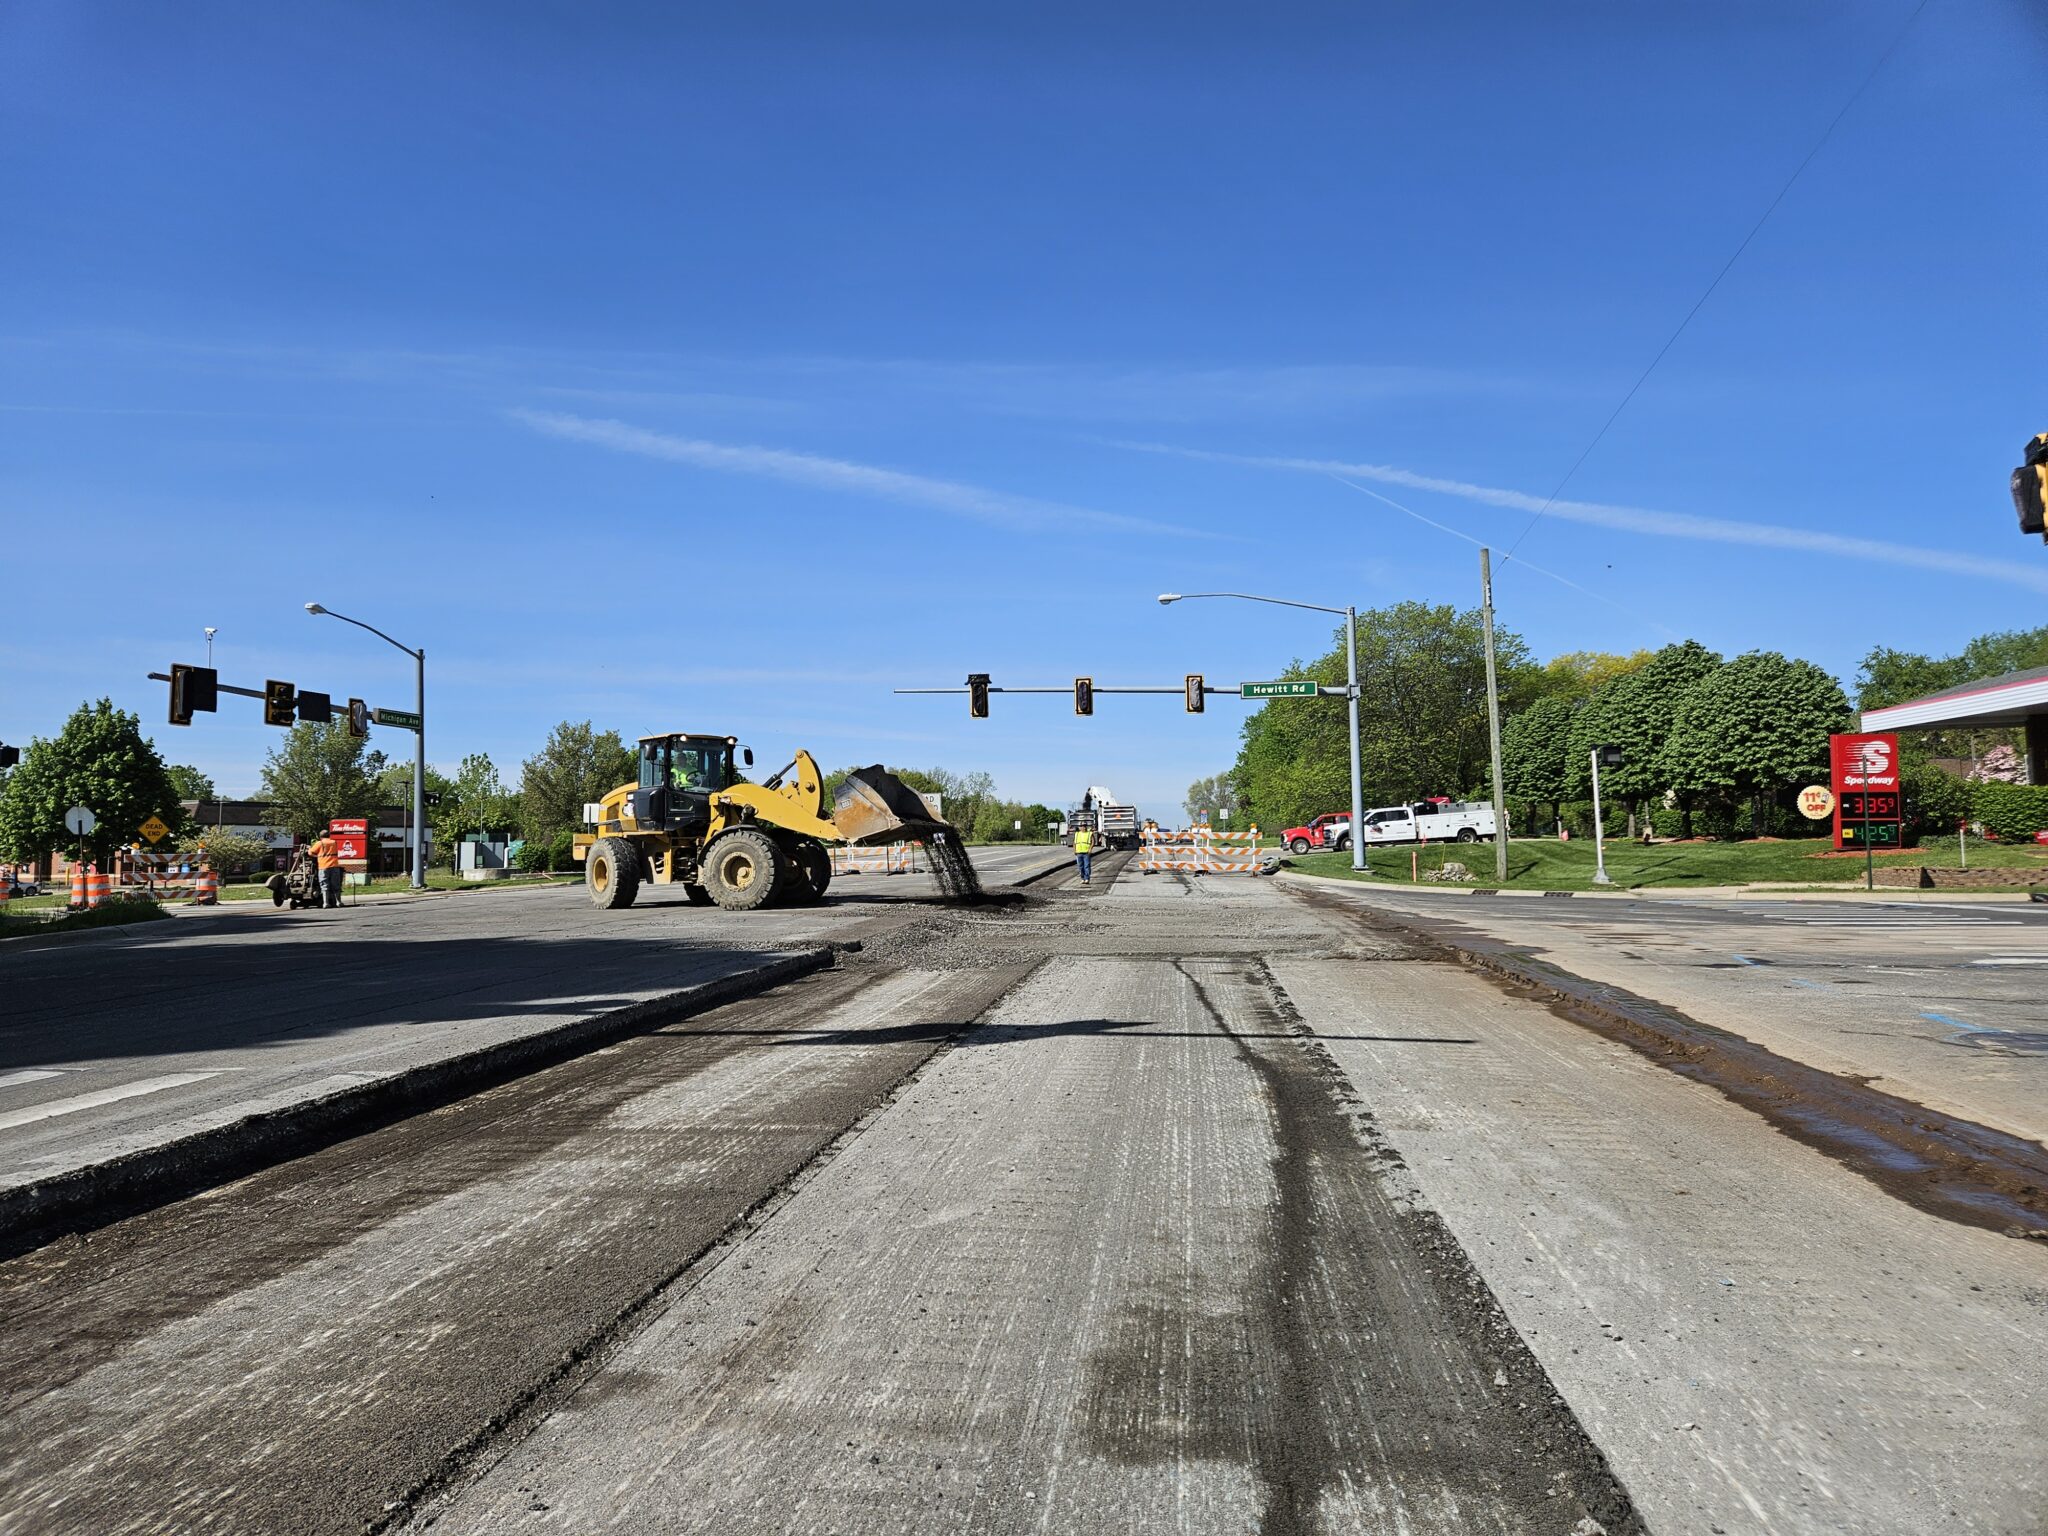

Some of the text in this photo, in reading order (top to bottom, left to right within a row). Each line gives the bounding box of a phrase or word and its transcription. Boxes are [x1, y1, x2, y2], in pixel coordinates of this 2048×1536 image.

[1253, 684, 1306, 694] Hewitt Rd
[380, 713, 419, 726] Michigan Ave
[1807, 804, 1827, 812] OFF
[332, 823, 365, 832] Tim Hortons
